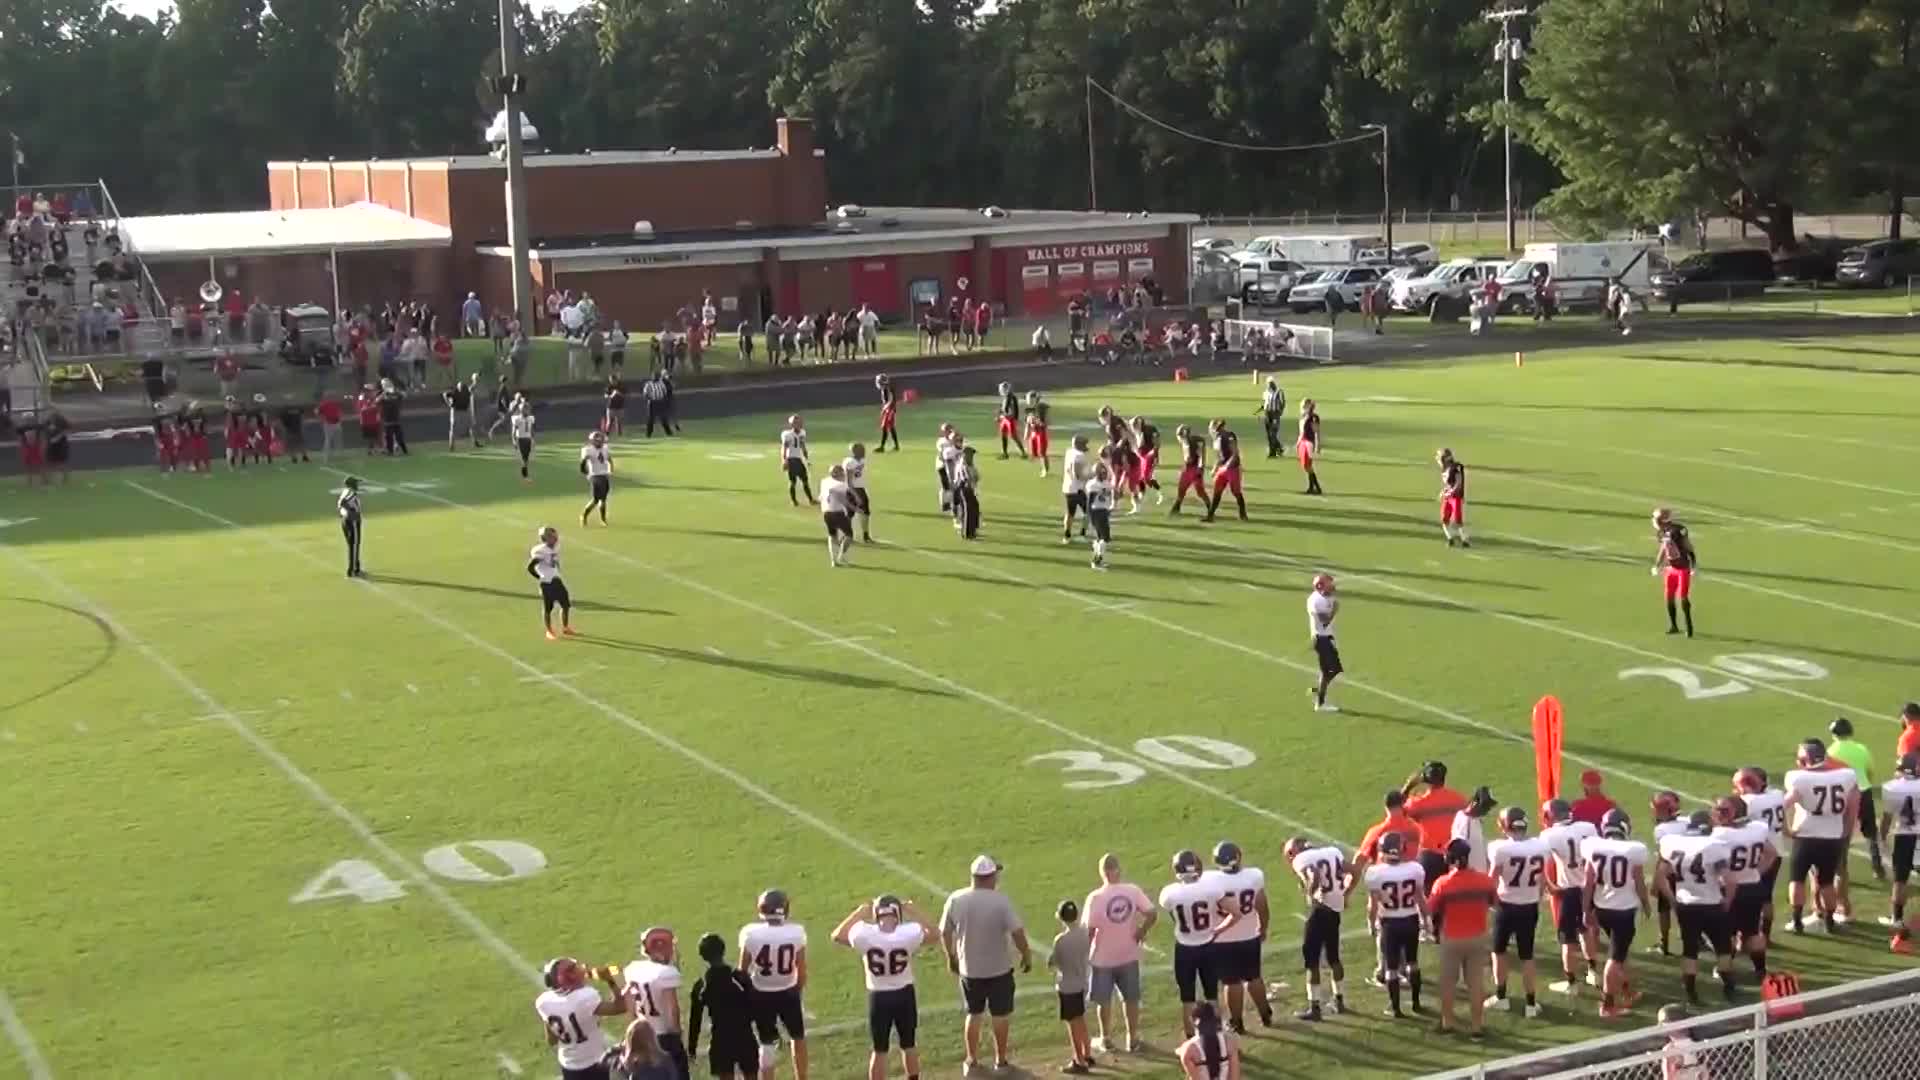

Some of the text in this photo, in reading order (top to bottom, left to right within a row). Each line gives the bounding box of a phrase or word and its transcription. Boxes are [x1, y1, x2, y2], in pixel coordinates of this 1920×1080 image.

[1063, 246, 1078, 258] OF
[1081, 242, 1149, 257] CHAMPIONS
[1617, 652, 1830, 700] 20
[1022, 734, 1257, 790] 30
[1812, 785, 1846, 816] 76
[1567, 837, 1587, 869] 1
[1670, 850, 1706, 884] 74
[1730, 842, 1763, 871] 60
[288, 839, 549, 903] 40
[1509, 855, 1545, 887] 72
[1592, 853, 1629, 888] 70
[1382, 879, 1417, 909] 32
[1176, 901, 1210, 933] 16
[755, 944, 793, 977] 40
[866, 948, 908, 976] 66
